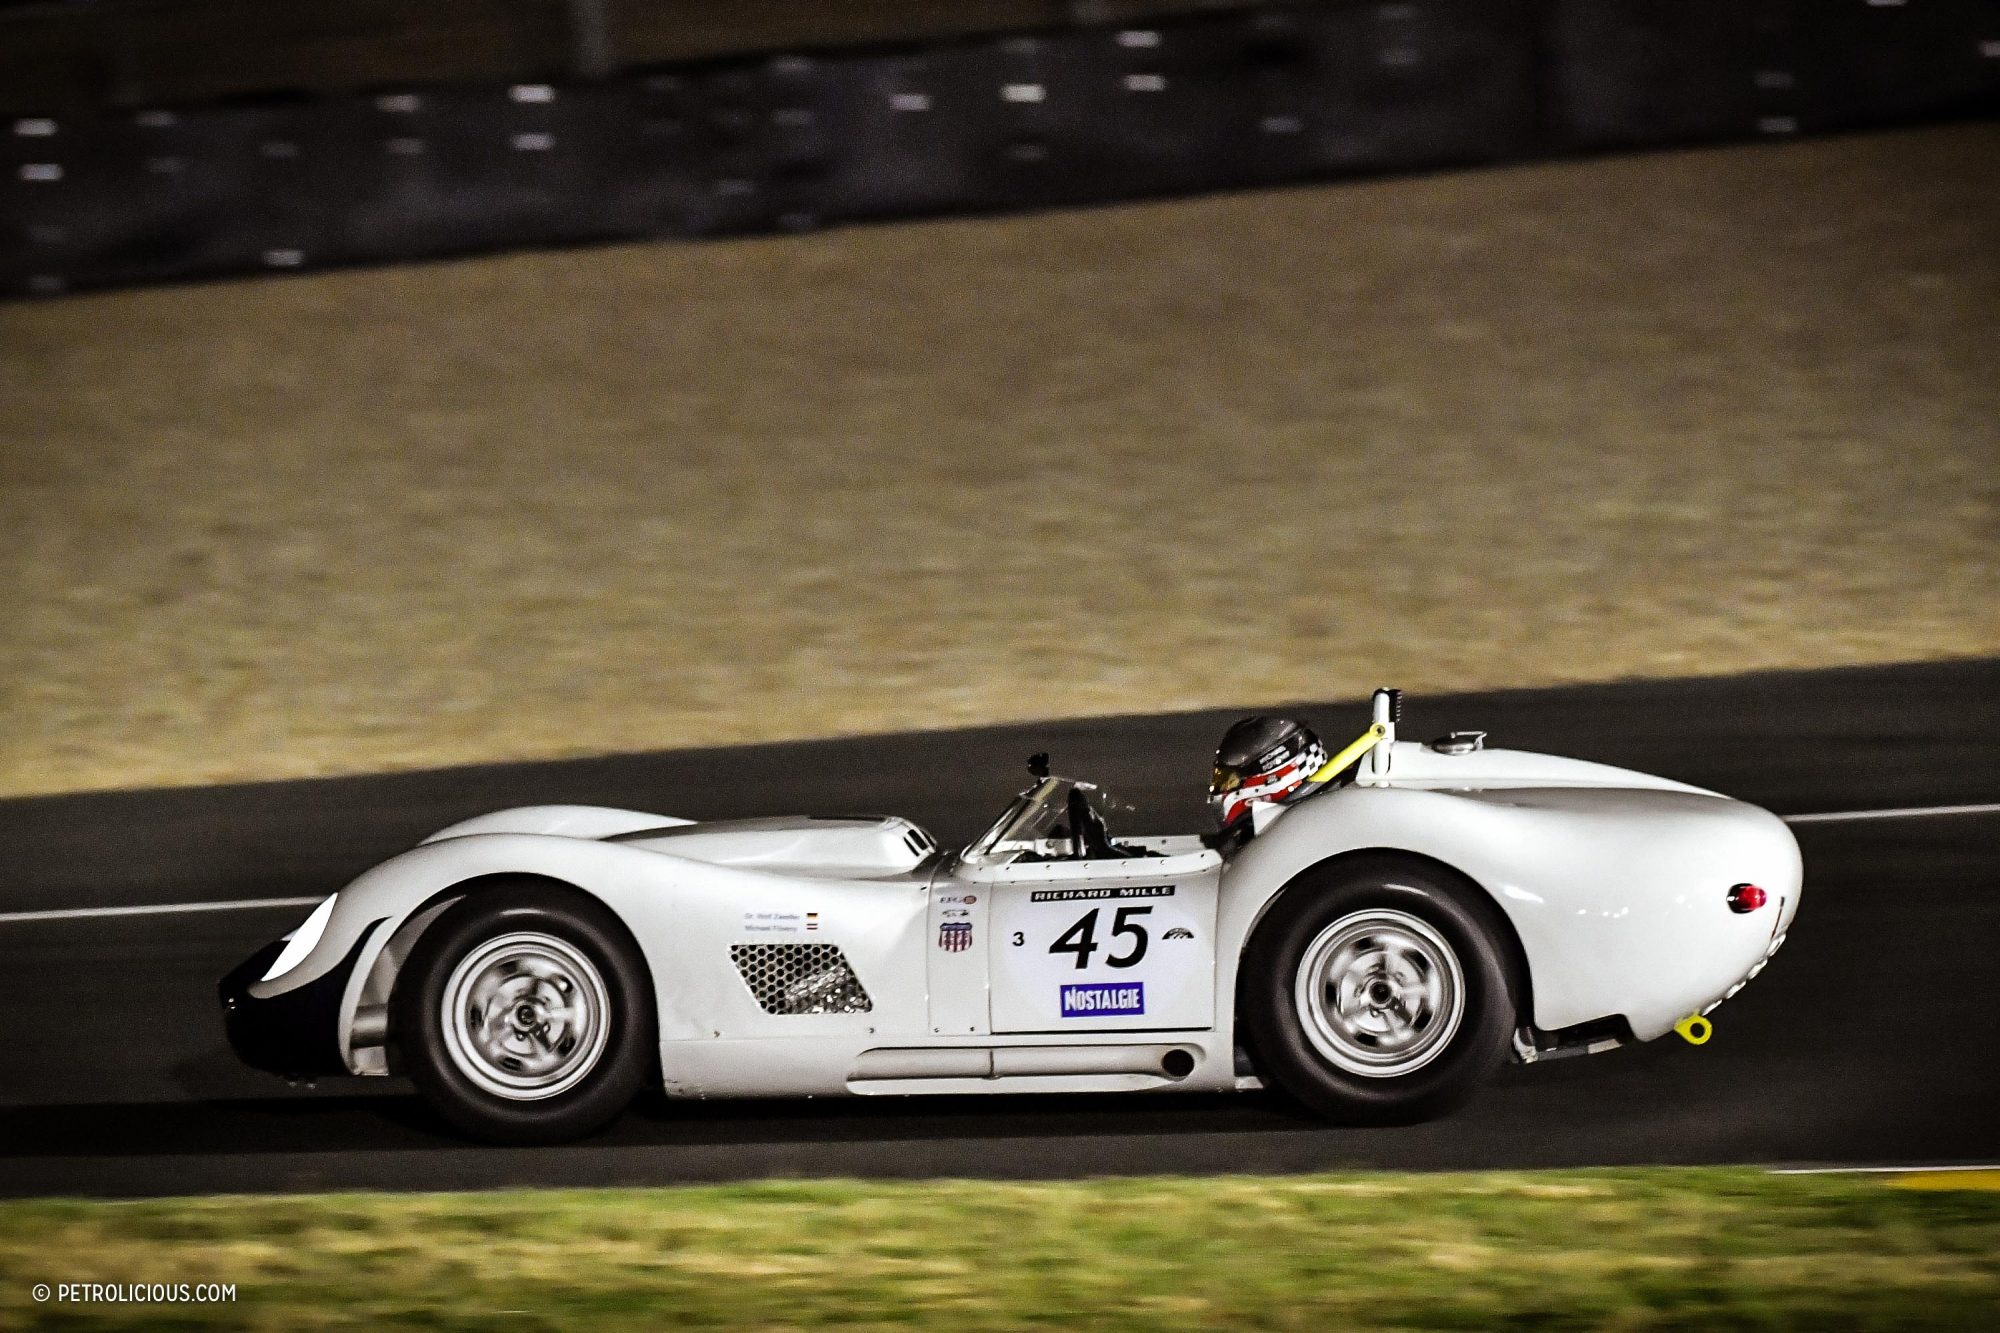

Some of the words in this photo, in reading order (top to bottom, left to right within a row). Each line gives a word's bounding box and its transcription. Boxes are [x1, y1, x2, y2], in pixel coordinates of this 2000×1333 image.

[1034, 889, 1110, 900] RICHARD
[1119, 886, 1171, 896] MILLE
[1012, 931, 1025, 946] 3
[1048, 905, 1153, 969] 45
[1064, 986, 1140, 1011] NOSTALGIE
